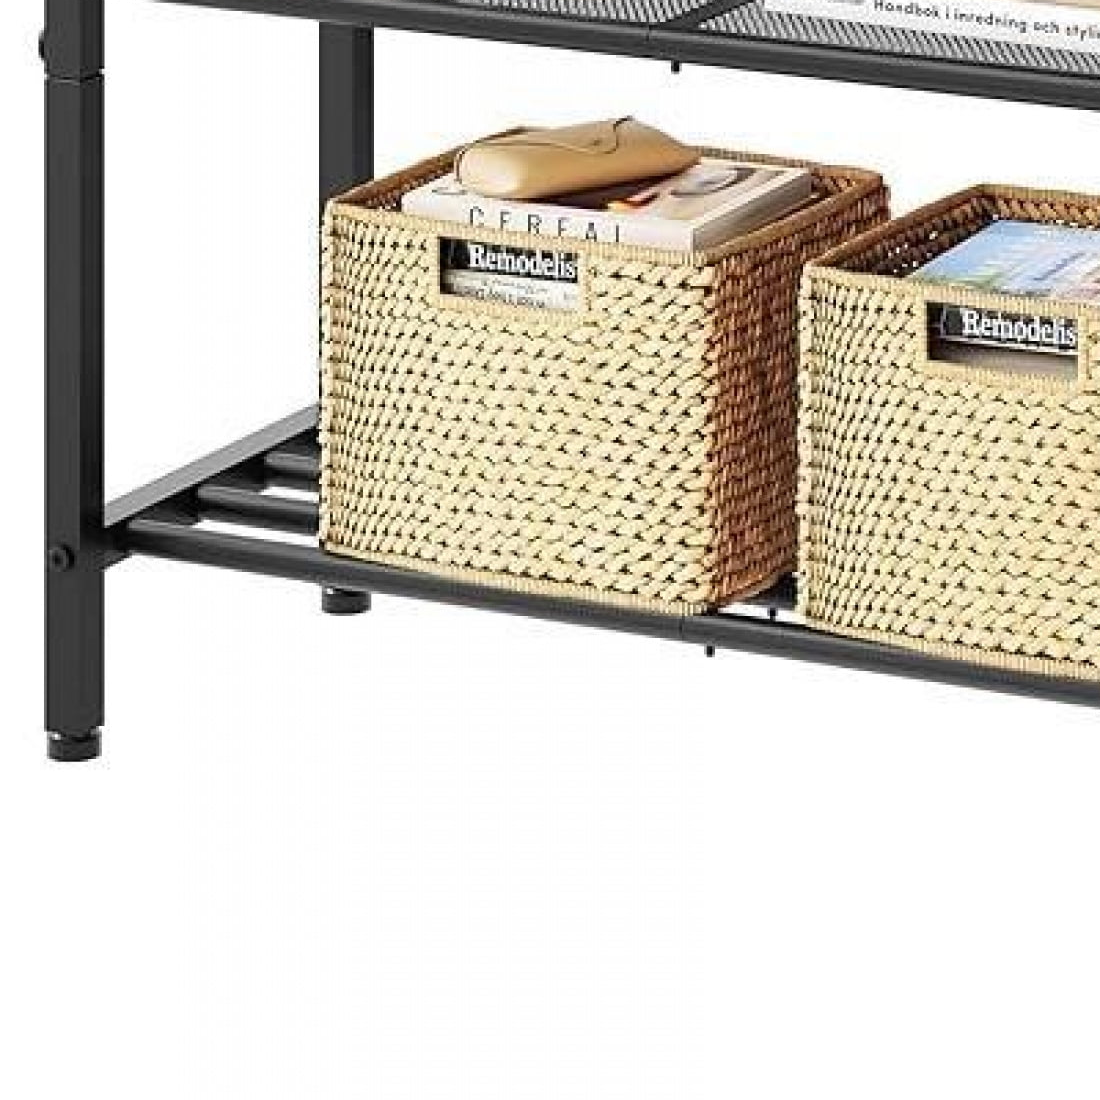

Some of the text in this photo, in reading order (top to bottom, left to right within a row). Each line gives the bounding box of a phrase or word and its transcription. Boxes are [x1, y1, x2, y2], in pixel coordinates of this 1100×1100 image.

[873, 0, 941, 19] Handbok
[953, 7, 1027, 33] inredning
[1033, 19, 1060, 34] och
